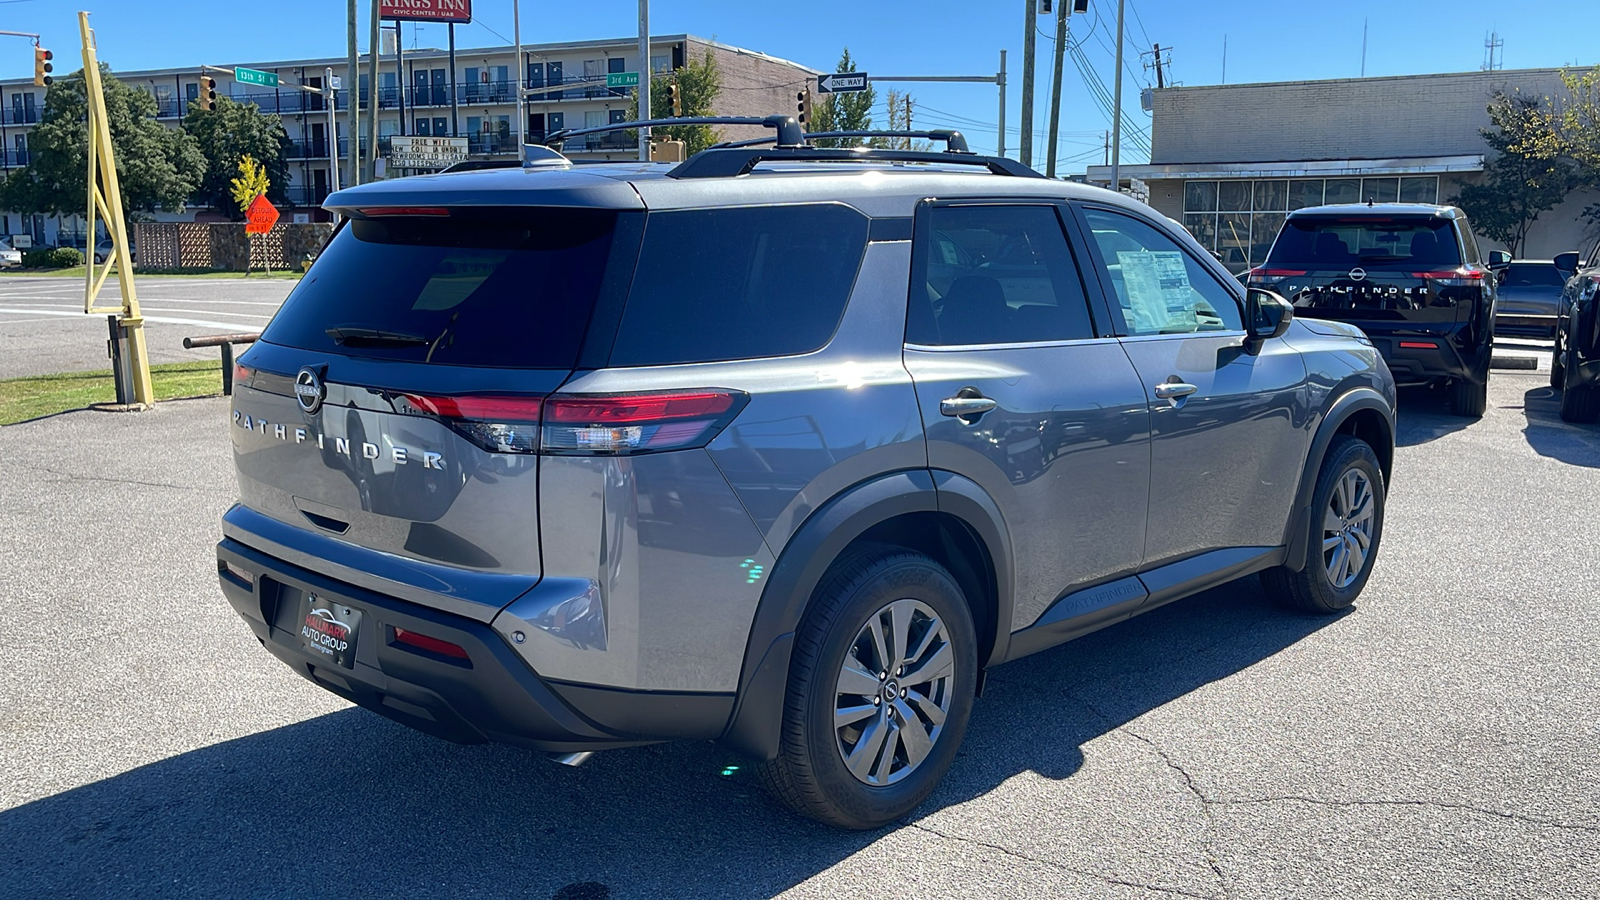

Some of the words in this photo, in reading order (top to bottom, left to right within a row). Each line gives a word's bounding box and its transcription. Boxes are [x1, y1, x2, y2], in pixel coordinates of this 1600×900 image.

[382, 0, 431, 9] KINGS
[437, 0, 465, 10] INN
[240, 71, 254, 80] 13th
[258, 74, 265, 83] St
[611, 76, 622, 84] 3rd
[626, 75, 638, 83] Ave
[831, 79, 845, 87] ONE
[847, 78, 862, 86] WAY
[1289, 285, 1429, 295] PATHFINDER
[234, 410, 444, 471] PATHFINDER
[1065, 582, 1141, 613] PATHFINDER
[305, 614, 347, 640] HALLMARK
[301, 625, 320, 642] AUTO
[320, 633, 348, 652] GROUP
